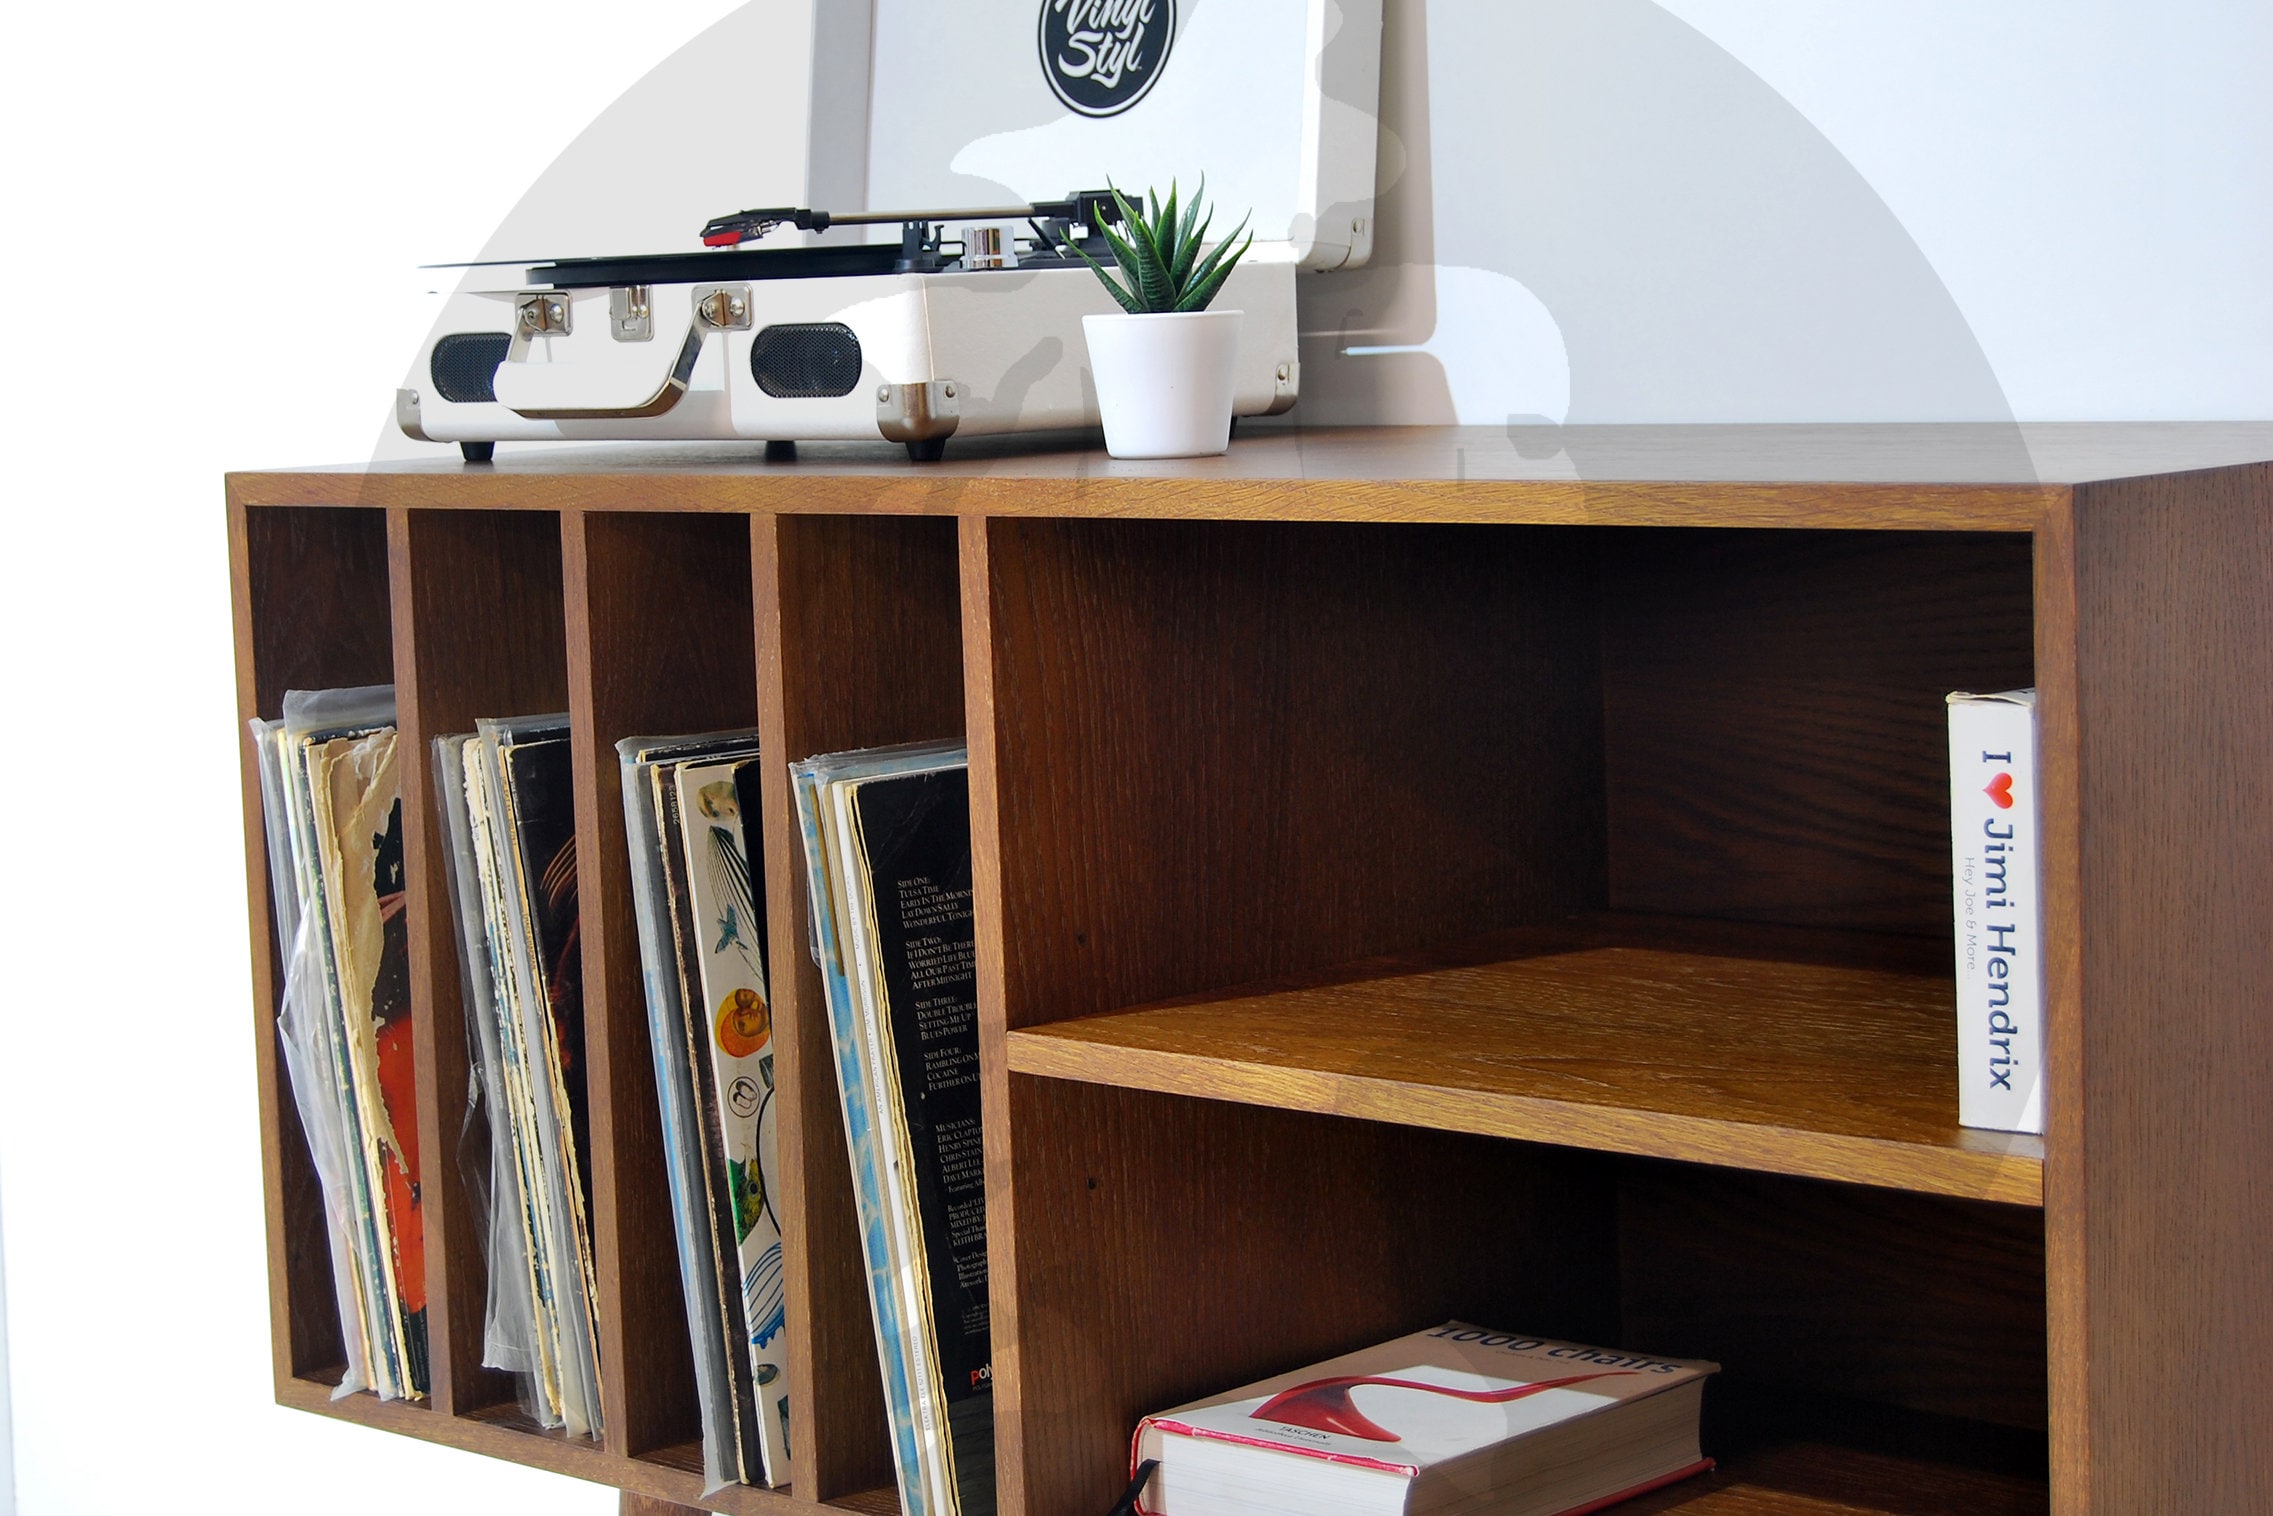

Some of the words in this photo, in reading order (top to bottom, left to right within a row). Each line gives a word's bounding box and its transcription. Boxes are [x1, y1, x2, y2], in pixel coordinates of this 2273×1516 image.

[1054, 0, 1156, 39] Vinyl
[1058, 22, 1145, 89] Styl
[1981, 749, 2012, 764] I
[1983, 817, 2015, 909] Jimi
[1963, 856, 1975, 886] Hey
[897, 880, 912, 889] SIDE
[899, 889, 921, 899] TULSA
[922, 885, 939, 895] TIME
[900, 899, 921, 909] EARLY
[921, 897, 930, 905] IN
[931, 894, 945, 903] THE
[1964, 888, 1976, 916] Joe
[901, 909, 915, 919] LAY
[915, 905, 937, 917] DOWN
[937, 902, 959, 912] SALLY
[1966, 919, 1977, 928] &
[905, 941, 921, 949] SIDE
[908, 957, 942, 970] WORRIED
[942, 954, 957, 964] LIFE
[910, 970, 925, 980] ALL
[925, 967, 942, 977] OUR
[942, 964, 960, 974] PAST
[912, 979, 937, 991] AFTER
[914, 1001, 931, 1010] SIDE
[1985, 922, 2019, 1091] Hendrix
[916, 1007, 946, 1020] DOUBLE
[919, 1018, 949, 1031] SETTING
[920, 1030, 942, 1041] BLUES
[942, 1025, 968, 1036] POWER
[923, 1051, 939, 1061] SIDE
[937, 1133, 953, 1144] ERIC
[961, 1147, 982, 1157] STAIN
[1427, 1327, 1545, 1351] 1000
[1547, 1346, 1683, 1374] chairs
[1280, 1426, 1331, 1440] TASCHEN
